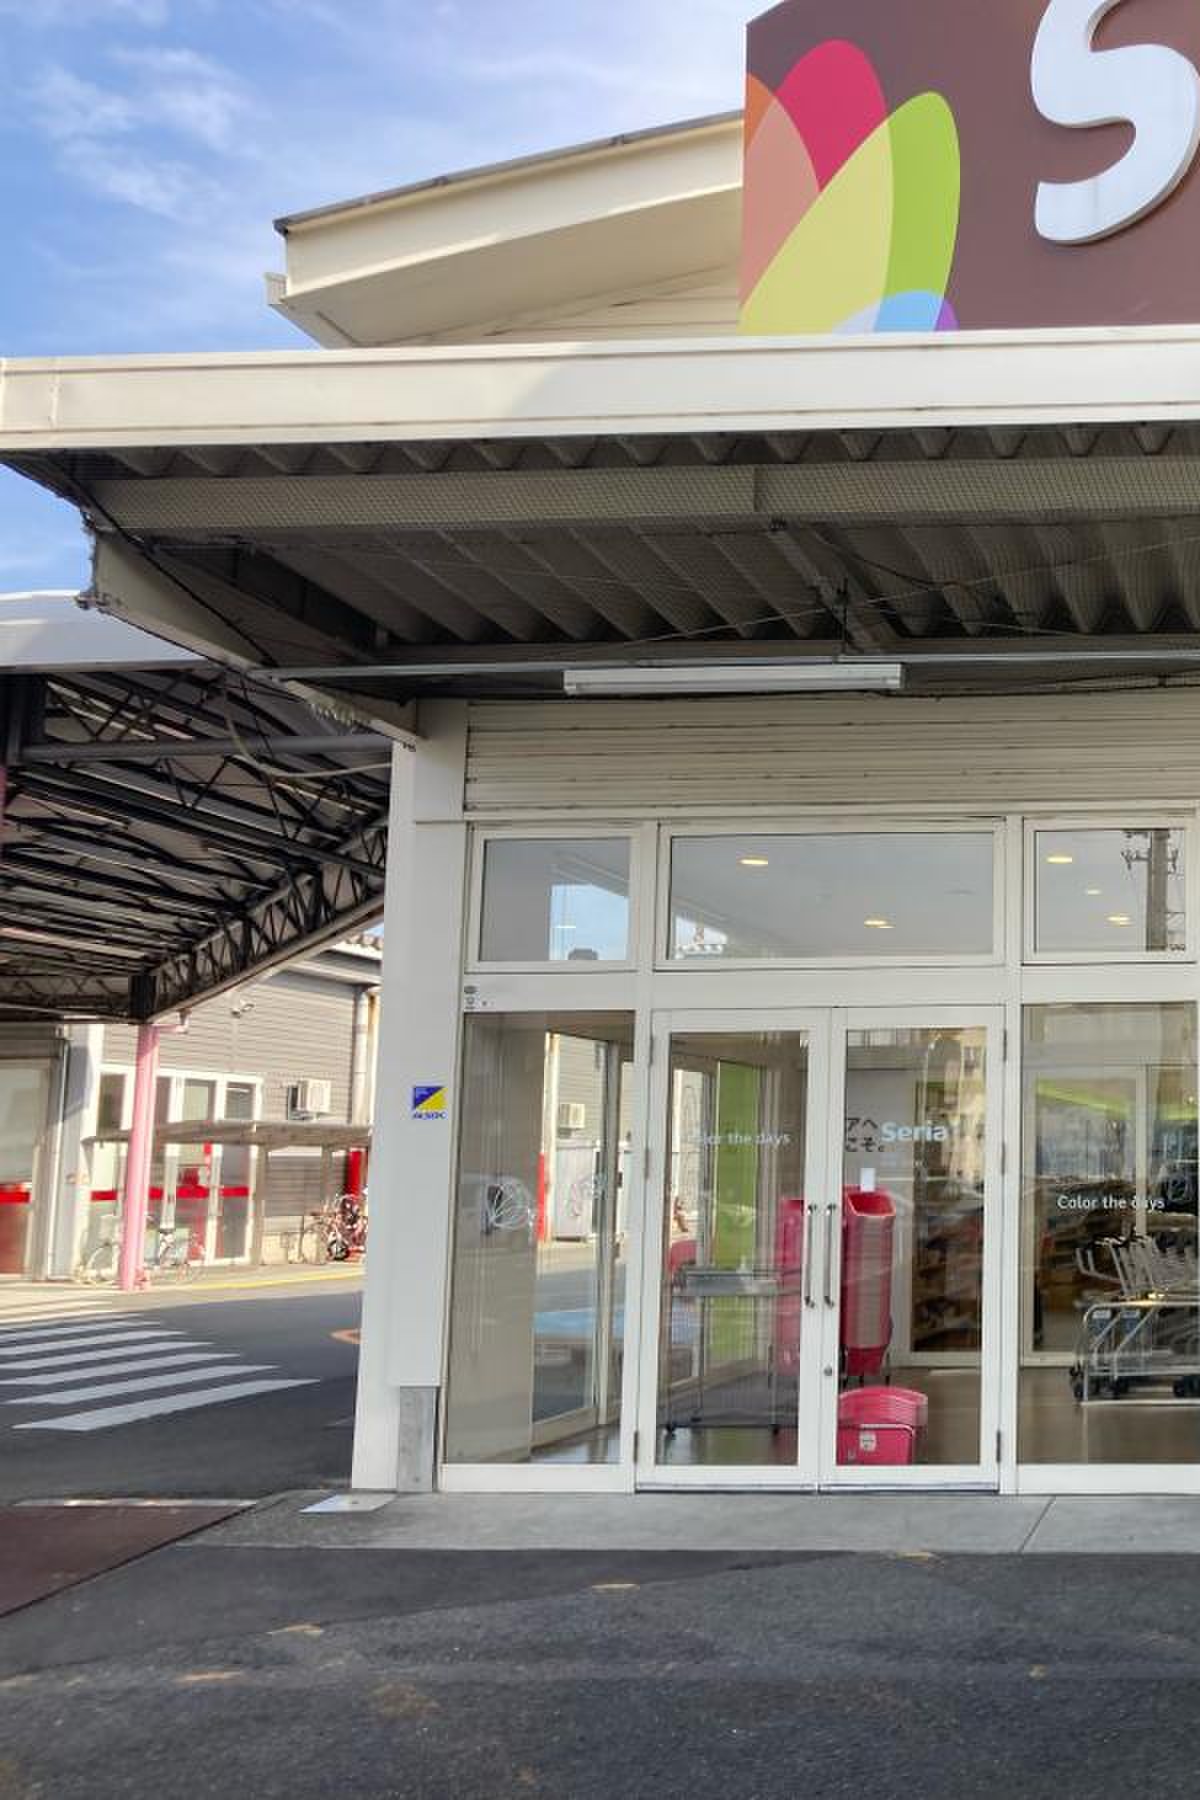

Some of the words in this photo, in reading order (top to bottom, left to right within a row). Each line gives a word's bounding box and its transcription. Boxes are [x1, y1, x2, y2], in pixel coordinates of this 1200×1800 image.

[881, 1119, 949, 1142] Seria
[1057, 1194, 1100, 1210] Color
[1103, 1194, 1127, 1210] the
[1131, 1195, 1165, 1214] dys
